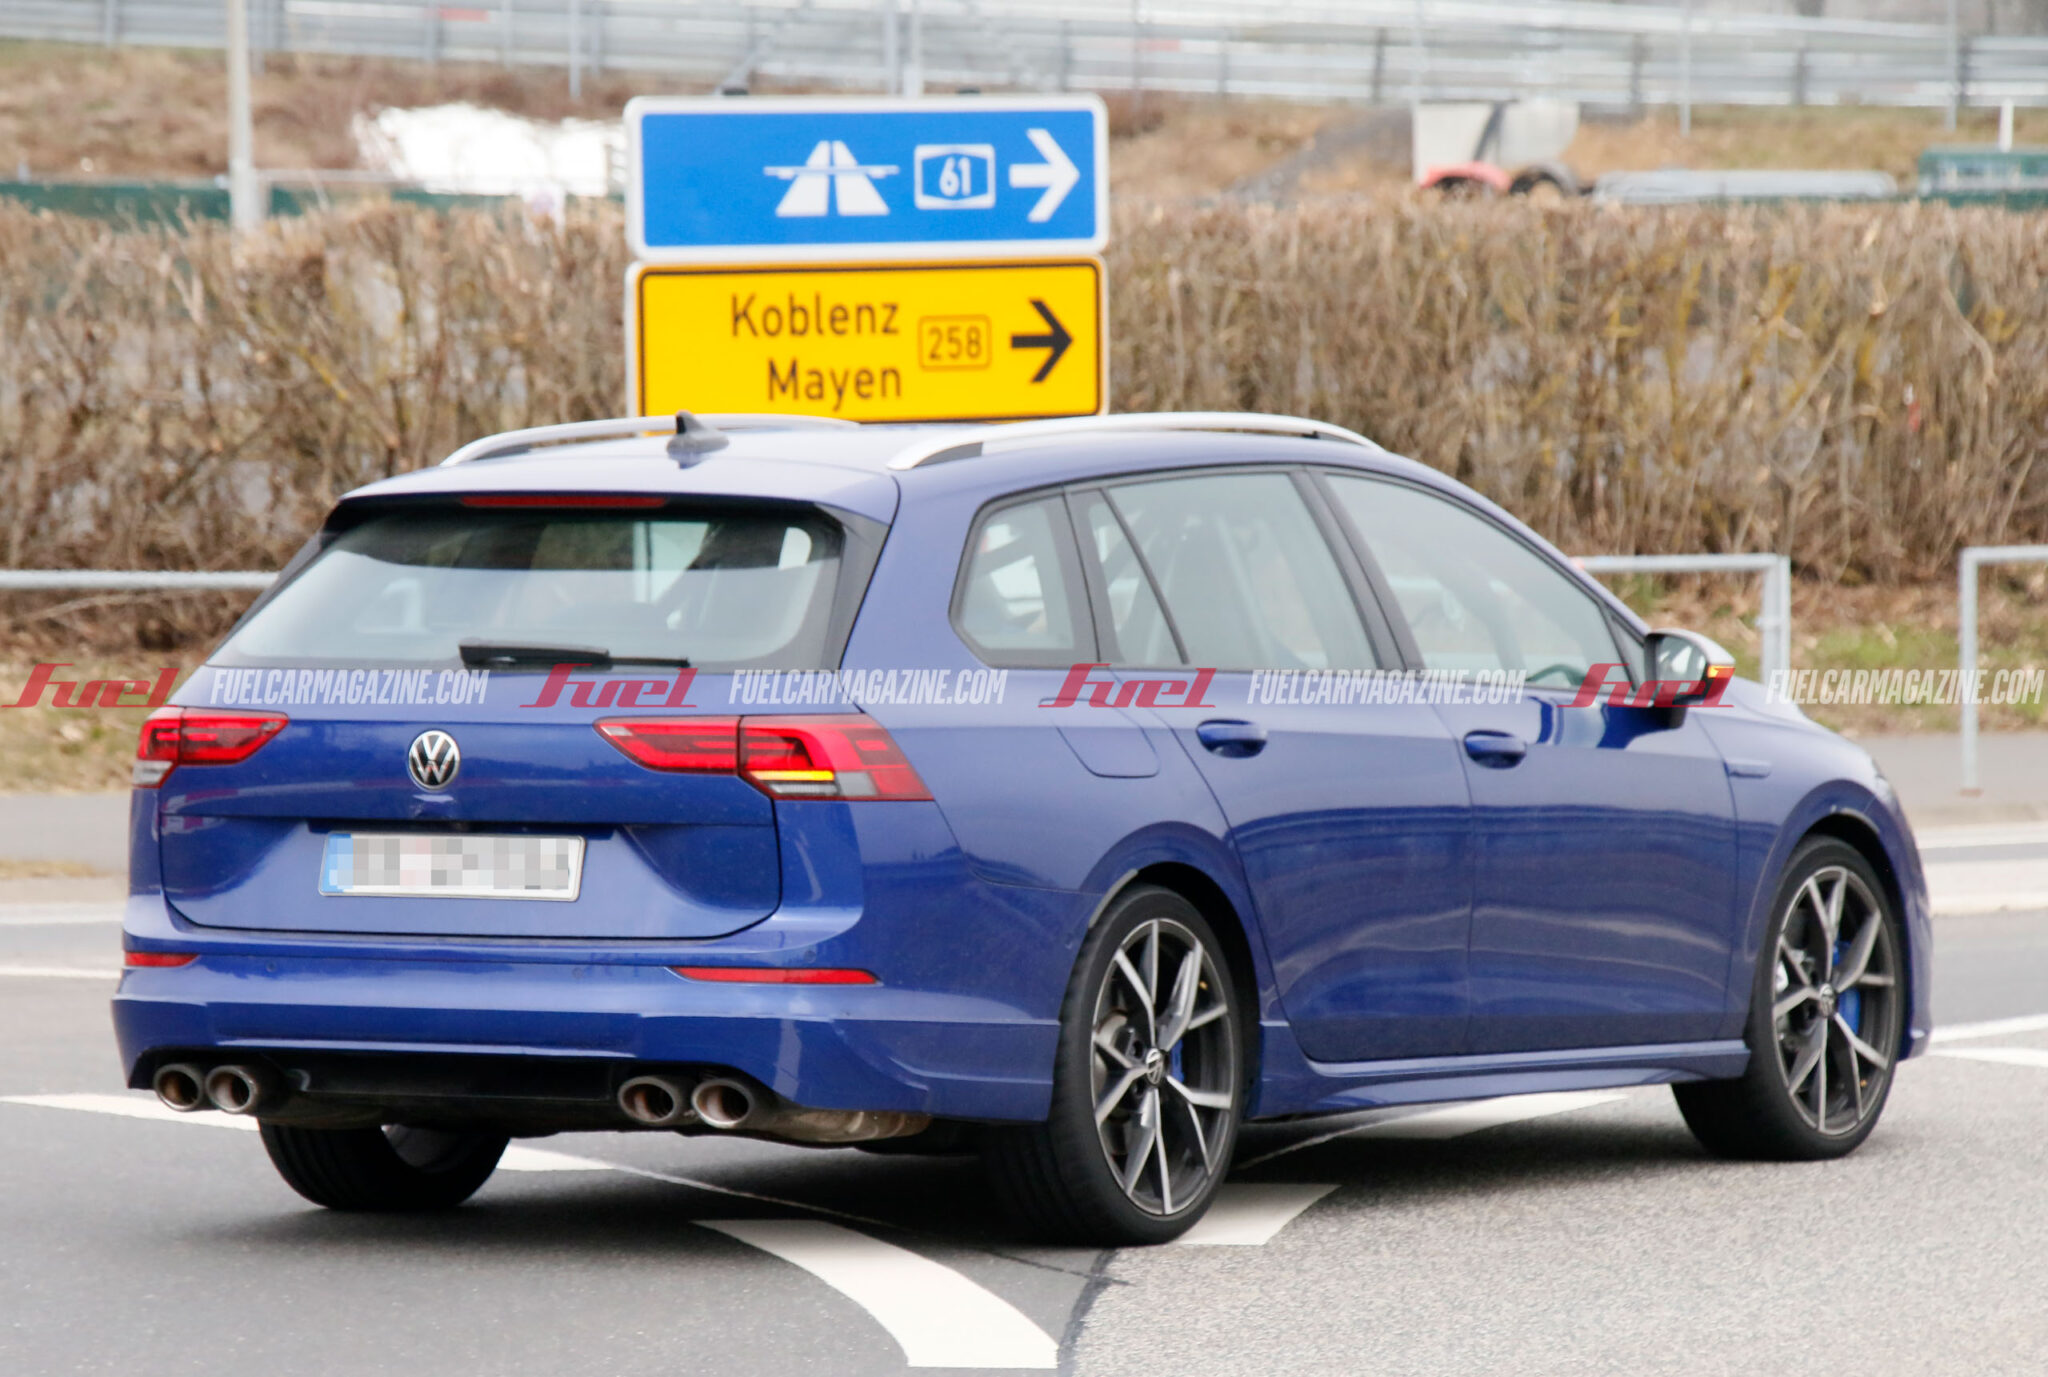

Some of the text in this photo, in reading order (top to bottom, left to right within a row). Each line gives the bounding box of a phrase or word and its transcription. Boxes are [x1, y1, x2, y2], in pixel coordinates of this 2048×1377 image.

[939, 156, 973, 197] 61
[732, 294, 901, 337] Koblenz
[928, 327, 983, 361] 258
[767, 358, 902, 411] Mayen
[410, 732, 458, 788] VW
